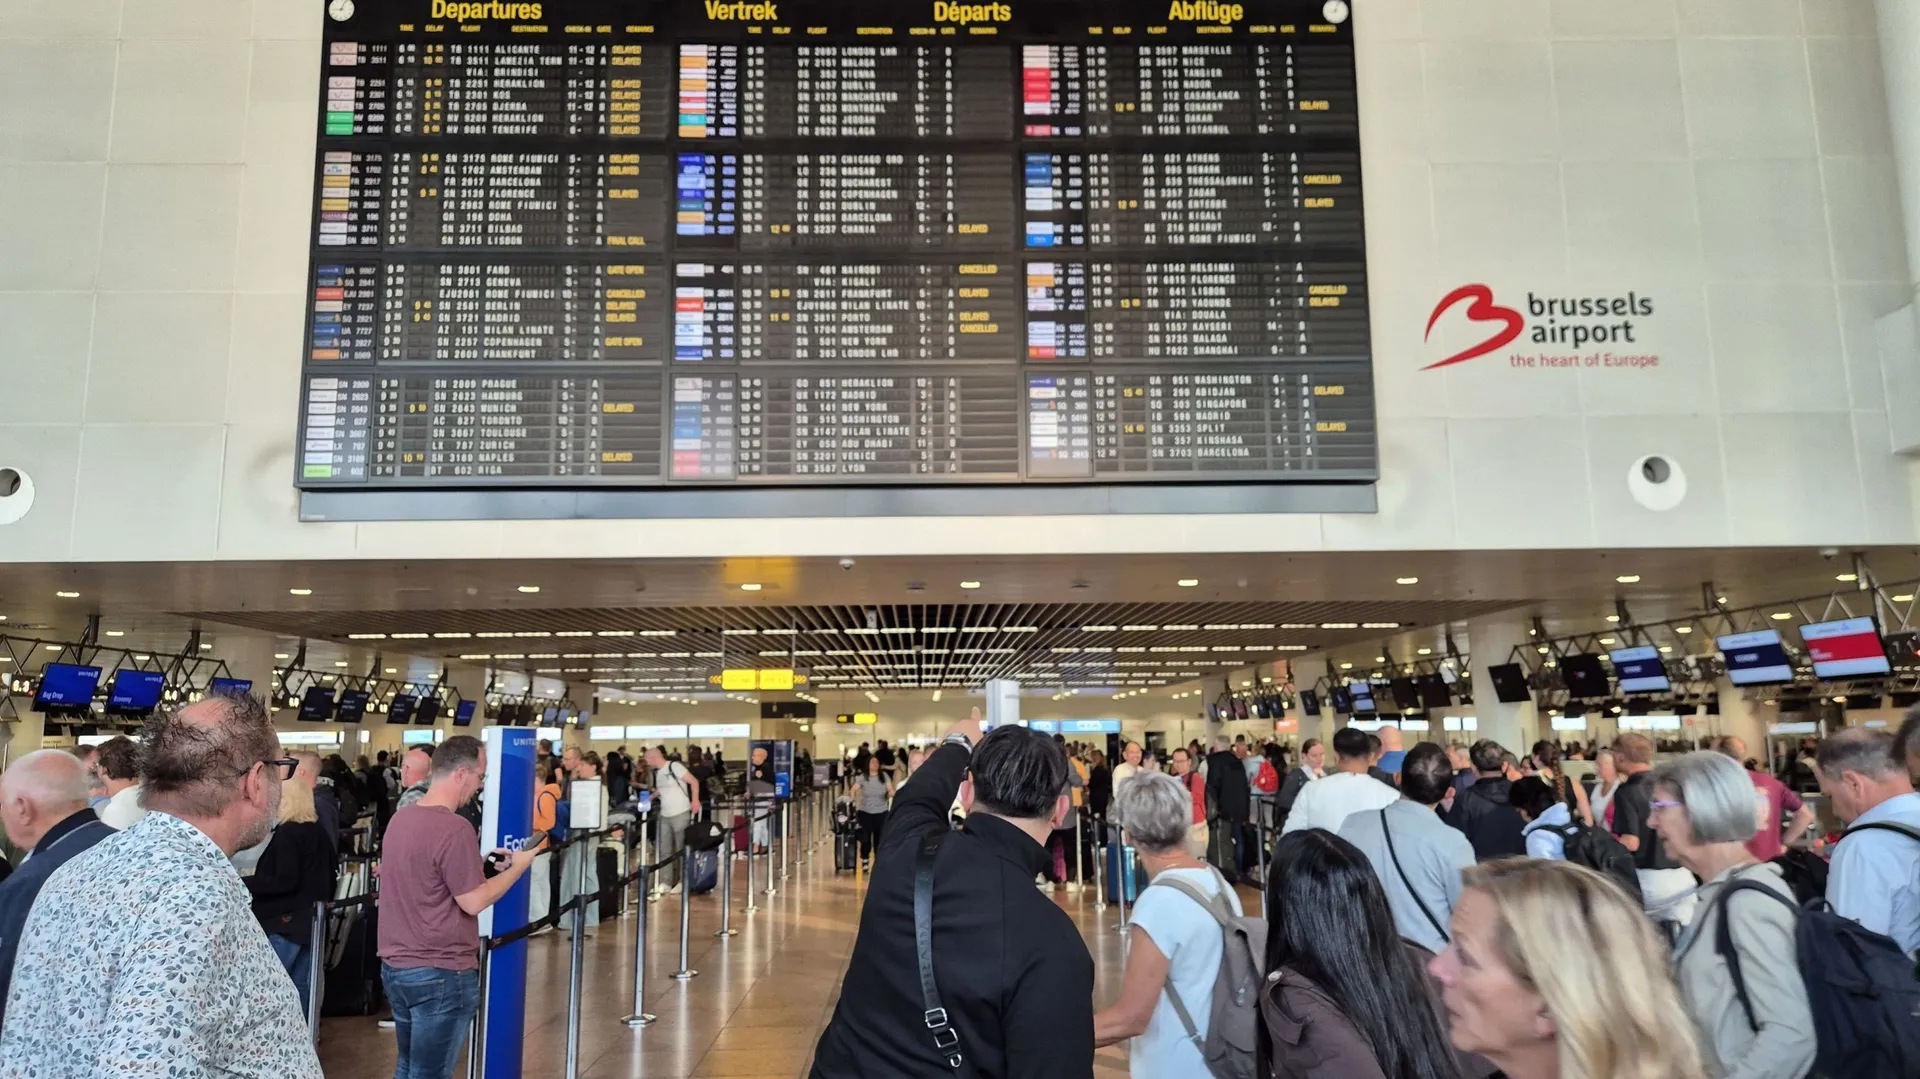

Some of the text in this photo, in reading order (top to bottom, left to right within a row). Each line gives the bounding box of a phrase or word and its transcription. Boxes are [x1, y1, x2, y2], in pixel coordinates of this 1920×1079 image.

[431, 0, 542, 22] Departures
[705, 1, 778, 20] Vertrek
[934, 1, 1011, 25] Départs
[1169, 1, 1243, 24] Abflüge
[1527, 292, 1653, 317] brussels
[1531, 319, 1636, 348] airport
[1510, 353, 1659, 368] the heart of Europe
[482, 380, 517, 388] PRAGUE
[1196, 424, 1225, 433] SPLIT
[513, 738, 538, 746] UNITE
